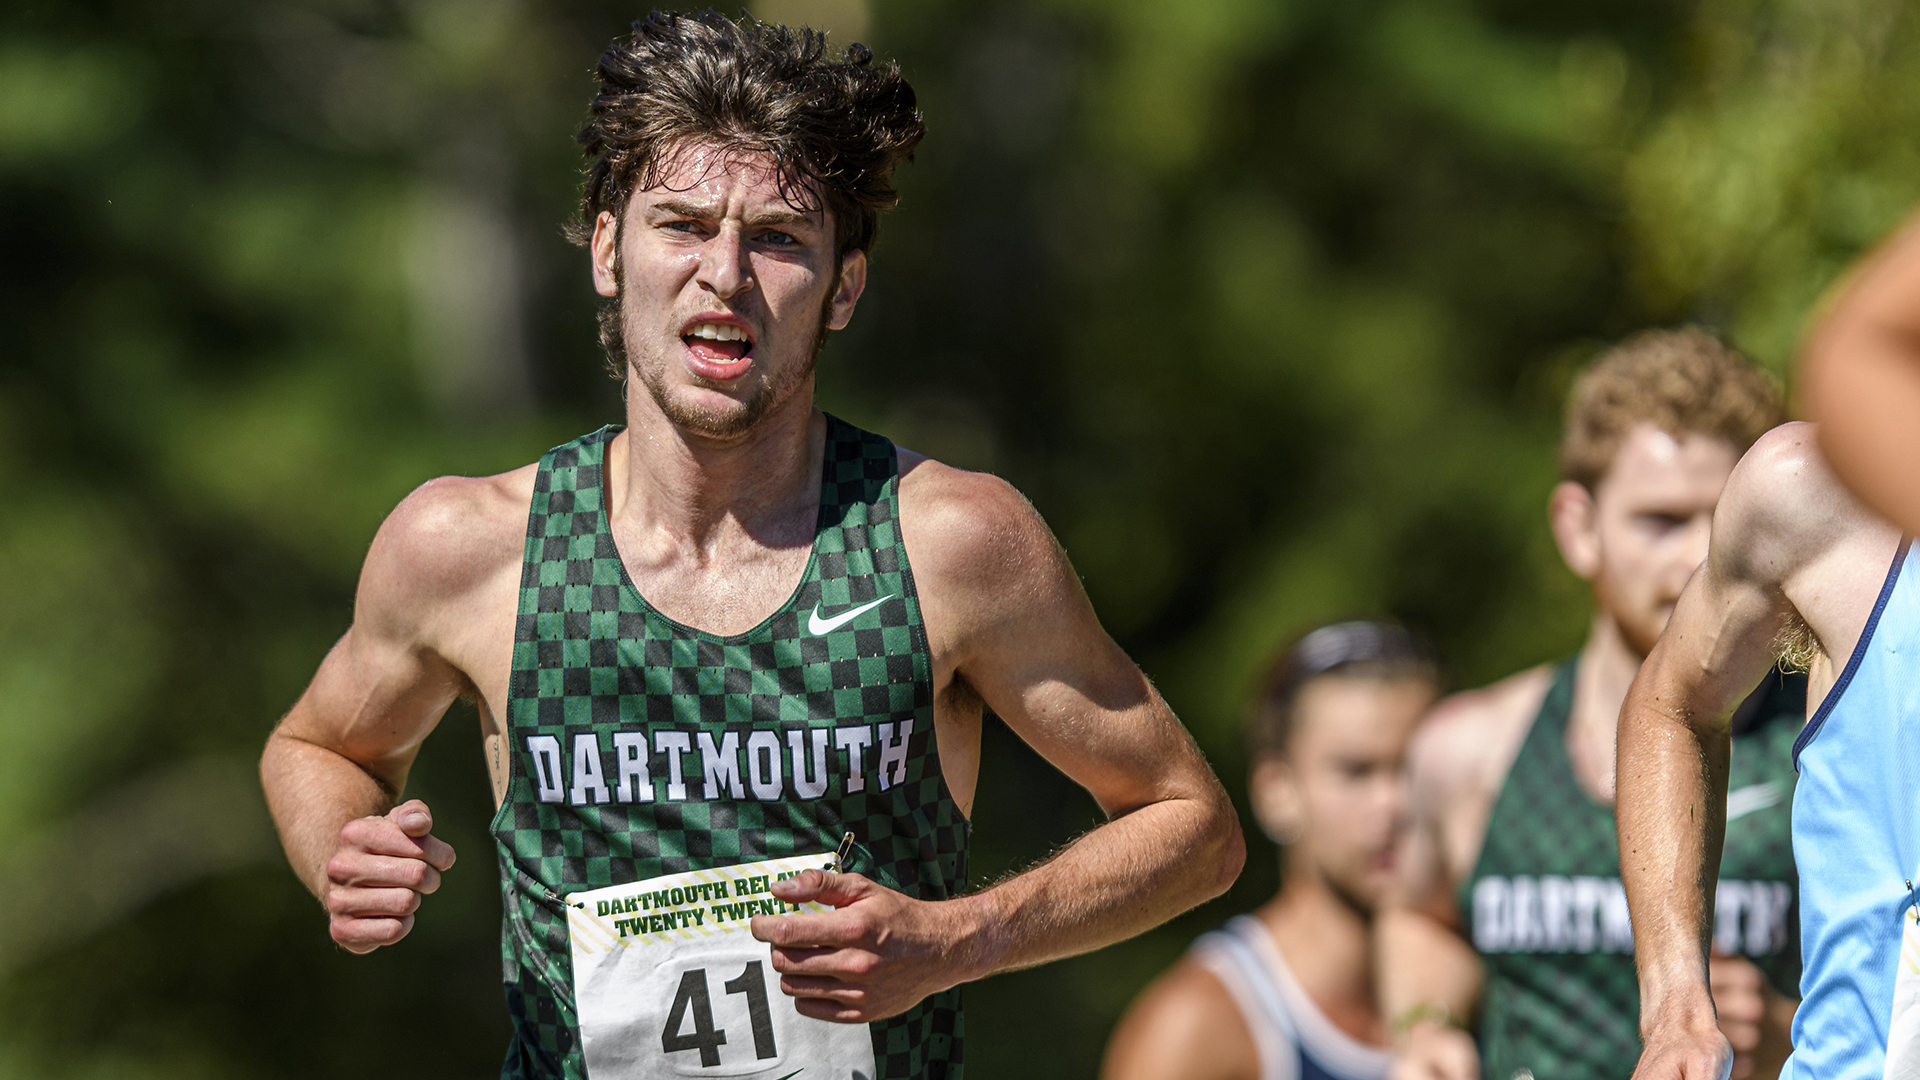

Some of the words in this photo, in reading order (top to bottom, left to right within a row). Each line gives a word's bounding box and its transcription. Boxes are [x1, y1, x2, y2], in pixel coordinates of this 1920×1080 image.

[525, 717, 915, 806] DARTMOUTH
[596, 881, 728, 917] DARTMOUTH
[614, 907, 705, 938] TWENTY
[661, 959, 778, 1068] 41
